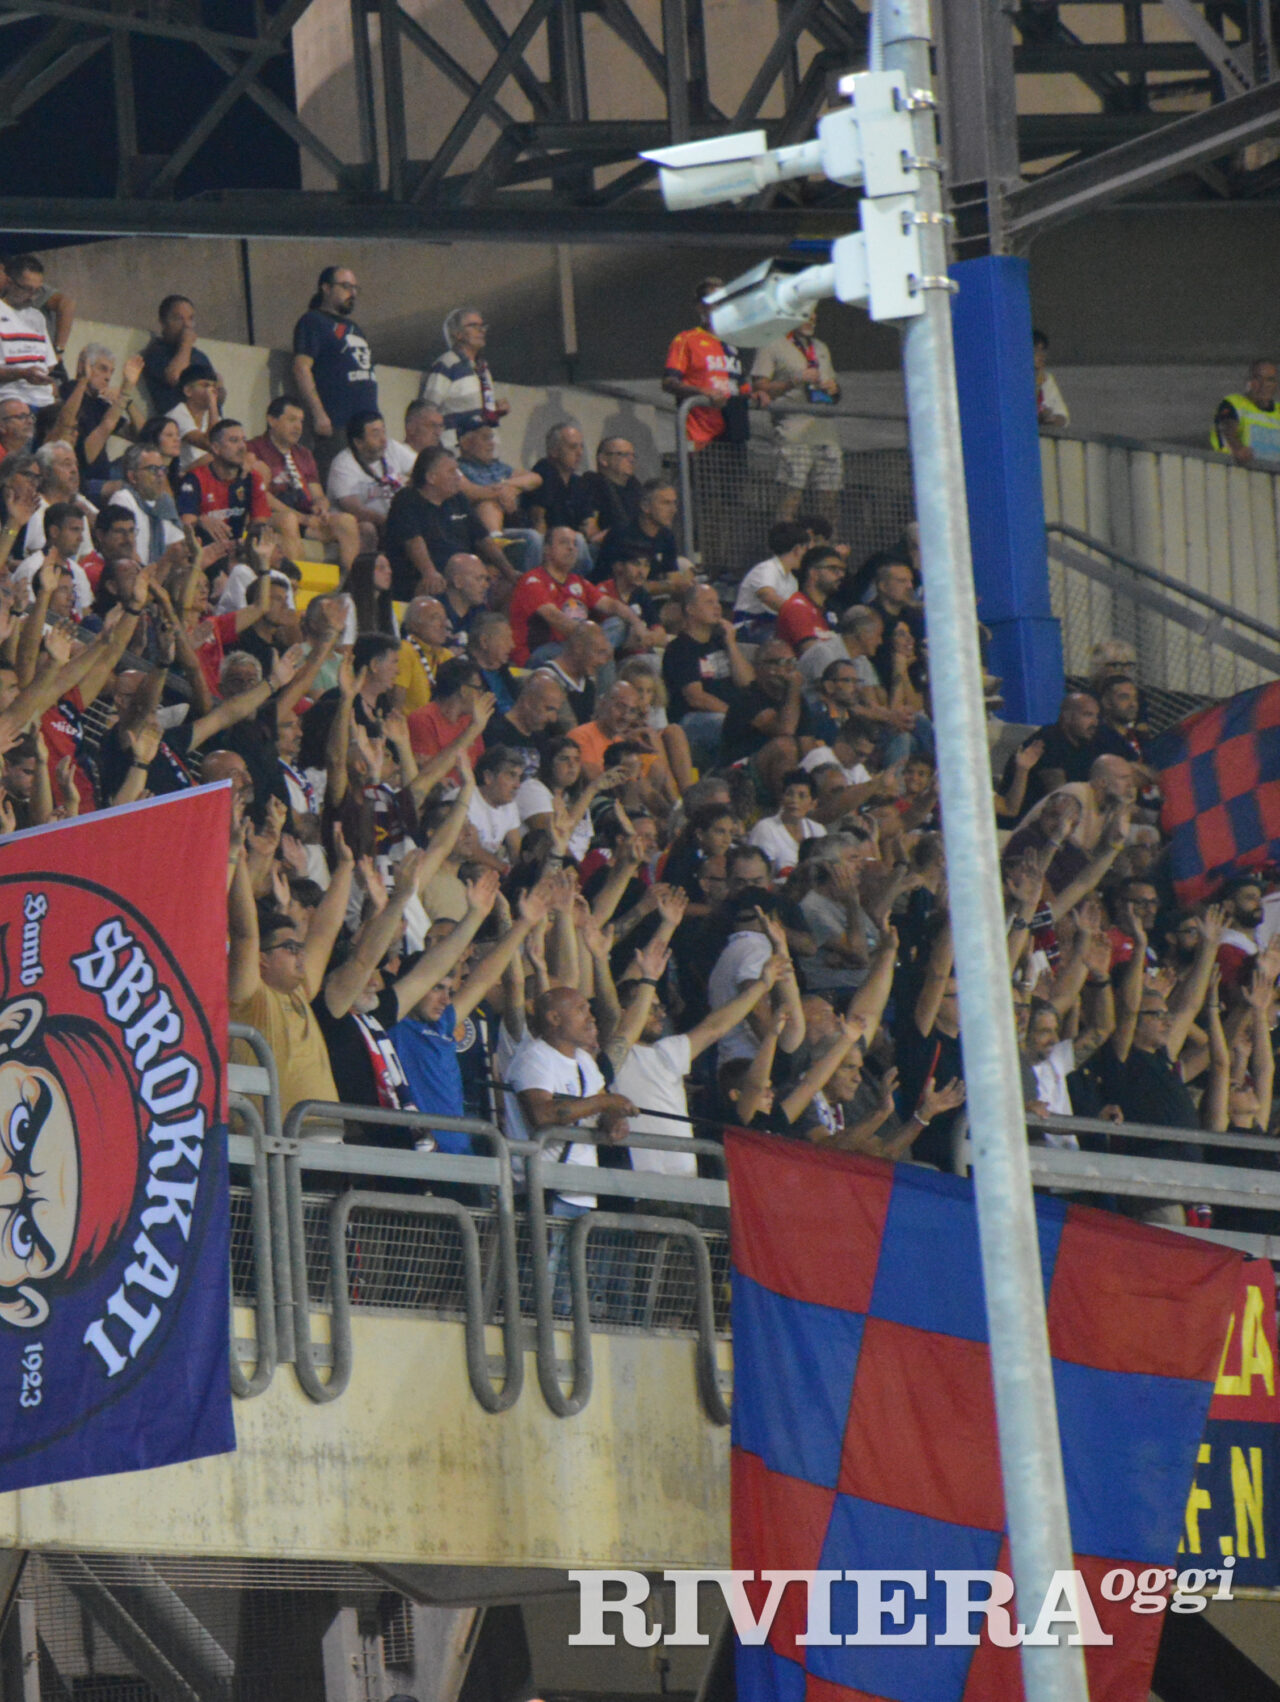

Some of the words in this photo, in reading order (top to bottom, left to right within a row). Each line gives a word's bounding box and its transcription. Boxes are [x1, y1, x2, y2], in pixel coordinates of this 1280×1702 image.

[18, 893, 48, 987] Samb
[72, 920, 205, 1377] SBROKKATI
[18, 1340, 44, 1409] 1923
